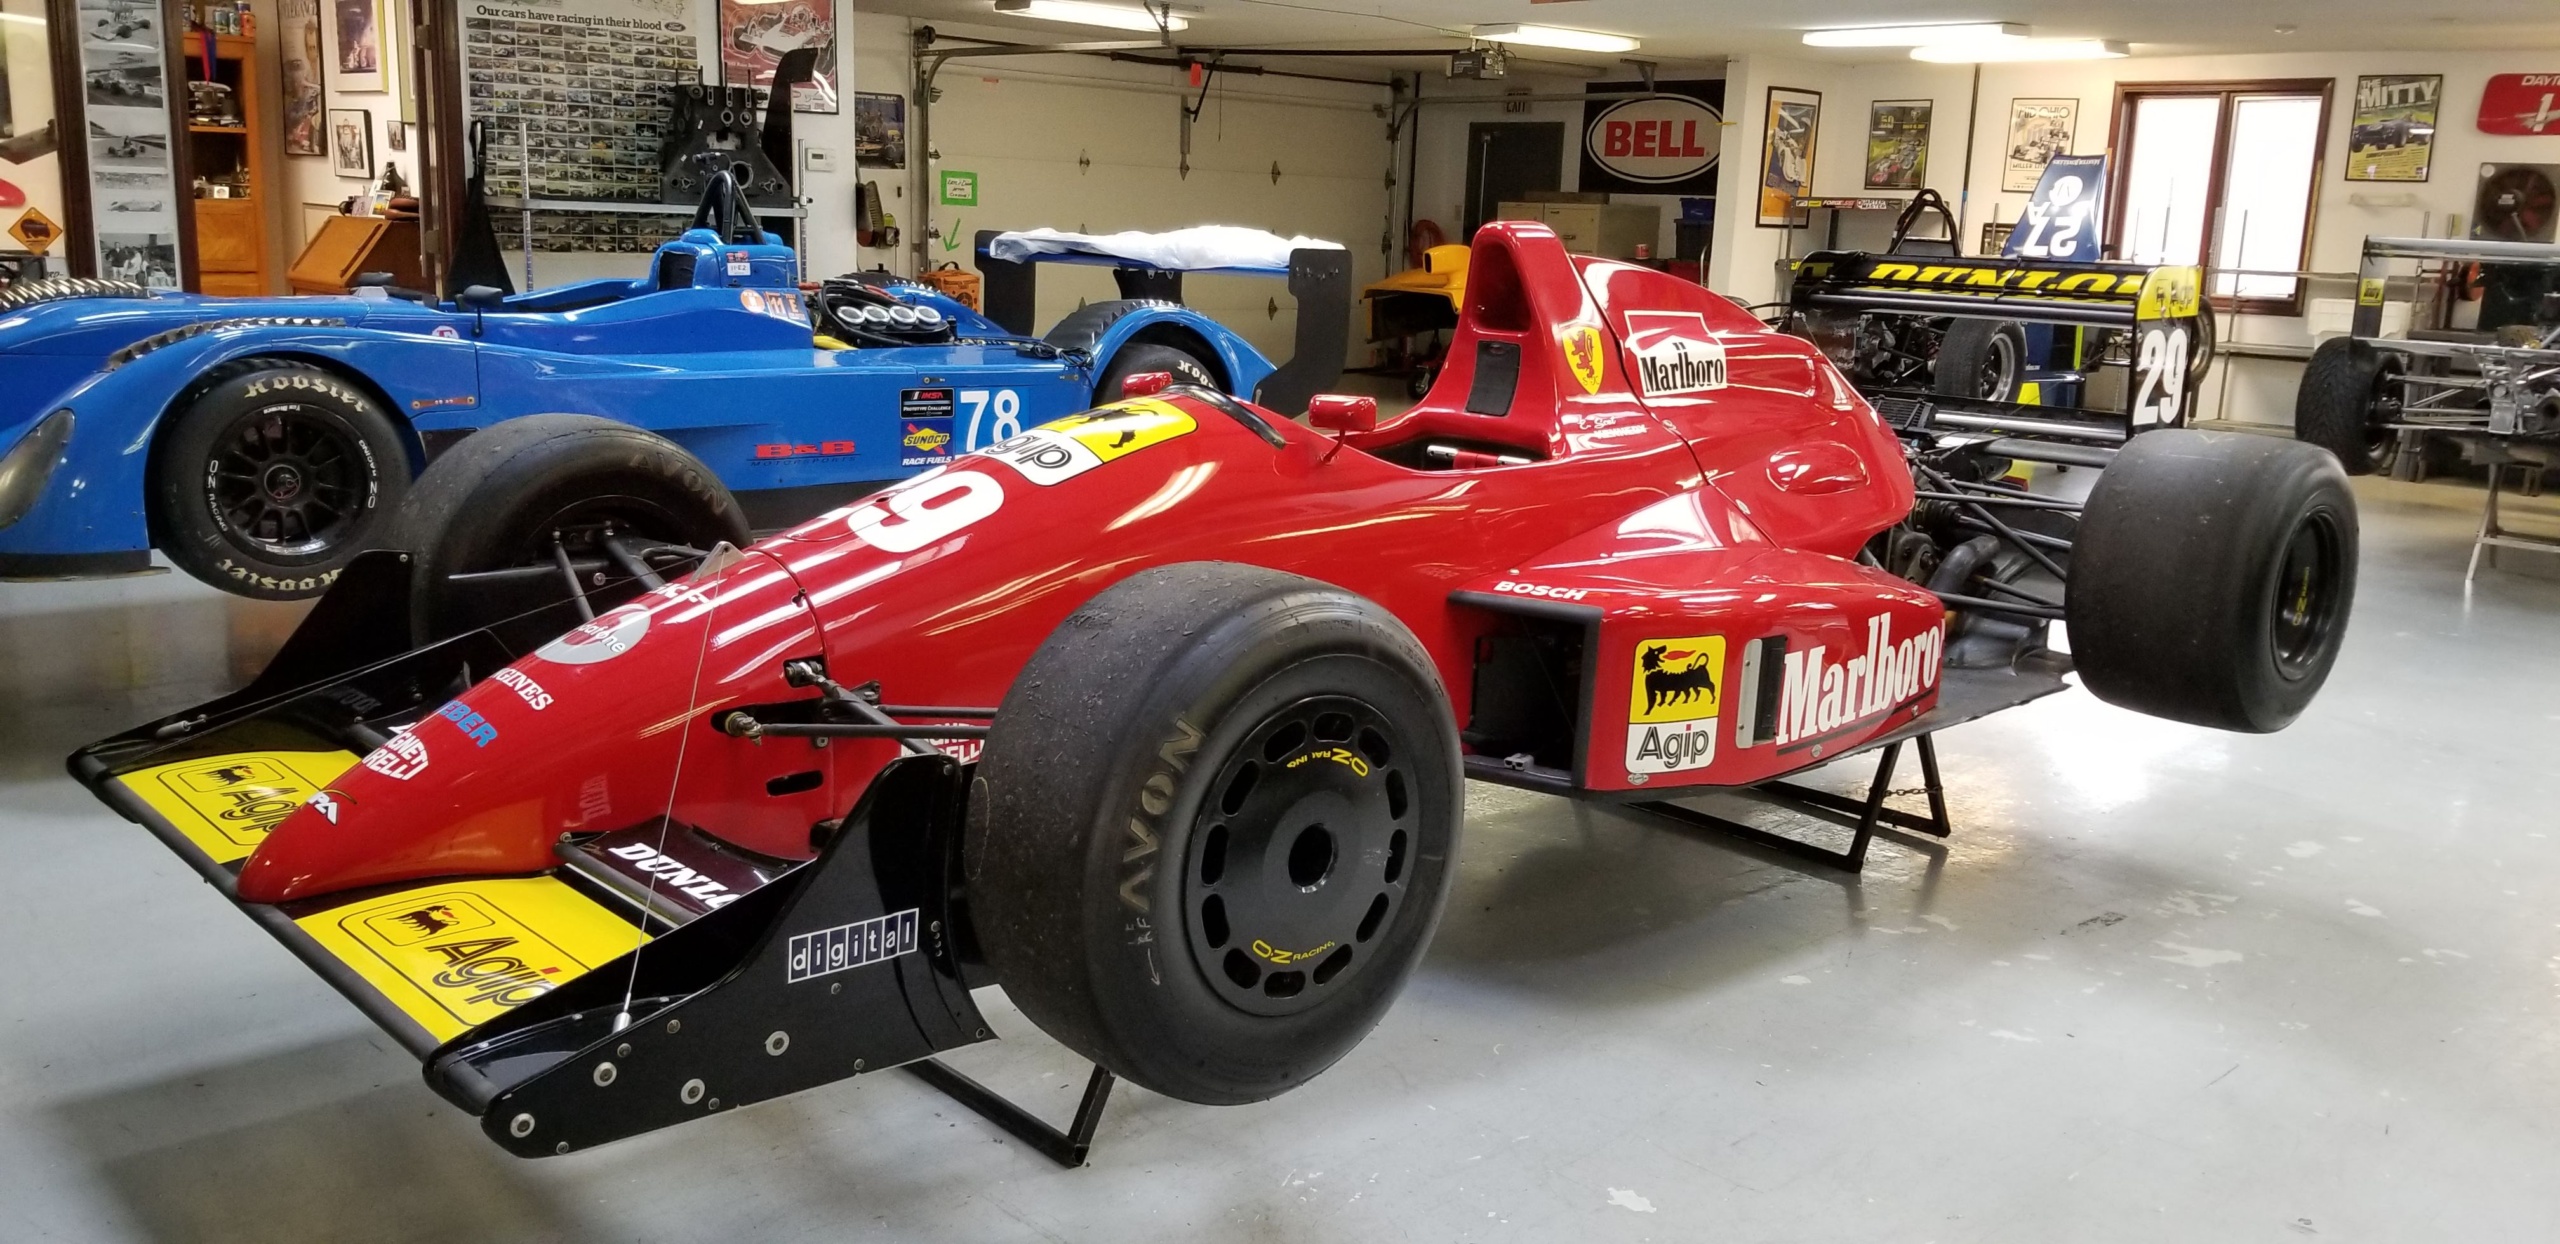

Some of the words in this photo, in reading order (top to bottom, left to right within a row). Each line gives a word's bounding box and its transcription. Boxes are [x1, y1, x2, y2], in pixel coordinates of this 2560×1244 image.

[476, 5, 500, 17] Our
[501, 9, 527, 19] cars
[528, 10, 555, 21] have
[556, 14, 592, 27] racing
[593, 15, 604, 26] in
[605, 17, 631, 28] their
[632, 19, 662, 31] blood
[2360, 80, 2438, 108] MITTY
[2361, 79, 2382, 90] THE
[1604, 120, 1705, 157] BELL
[1640, 342, 1724, 393] Marlboro
[2132, 328, 2188, 426] 29
[244, 375, 369, 412] Hoosier
[906, 434, 948, 445] SUNOCO
[960, 390, 1021, 453] 78
[359, 439, 377, 477] RACING
[751, 457, 857, 467] MOTORSPORTS
[756, 441, 855, 458] B&B
[902, 457, 926, 466] RACE
[926, 455, 952, 465] FUELS
[985, 435, 1073, 470] gip
[629, 452, 728, 515] AVON
[209, 493, 229, 532] RACING
[1493, 580, 1589, 600] BOSCH
[1776, 612, 1940, 746] Marlboro
[439, 699, 498, 748] EBER
[1635, 724, 1710, 769] Agip
[1119, 717, 1206, 912] AVON
[792, 918, 912, 974] digital
[1292, 941, 1335, 961] RACING
[424, 936, 561, 1007] Agip
